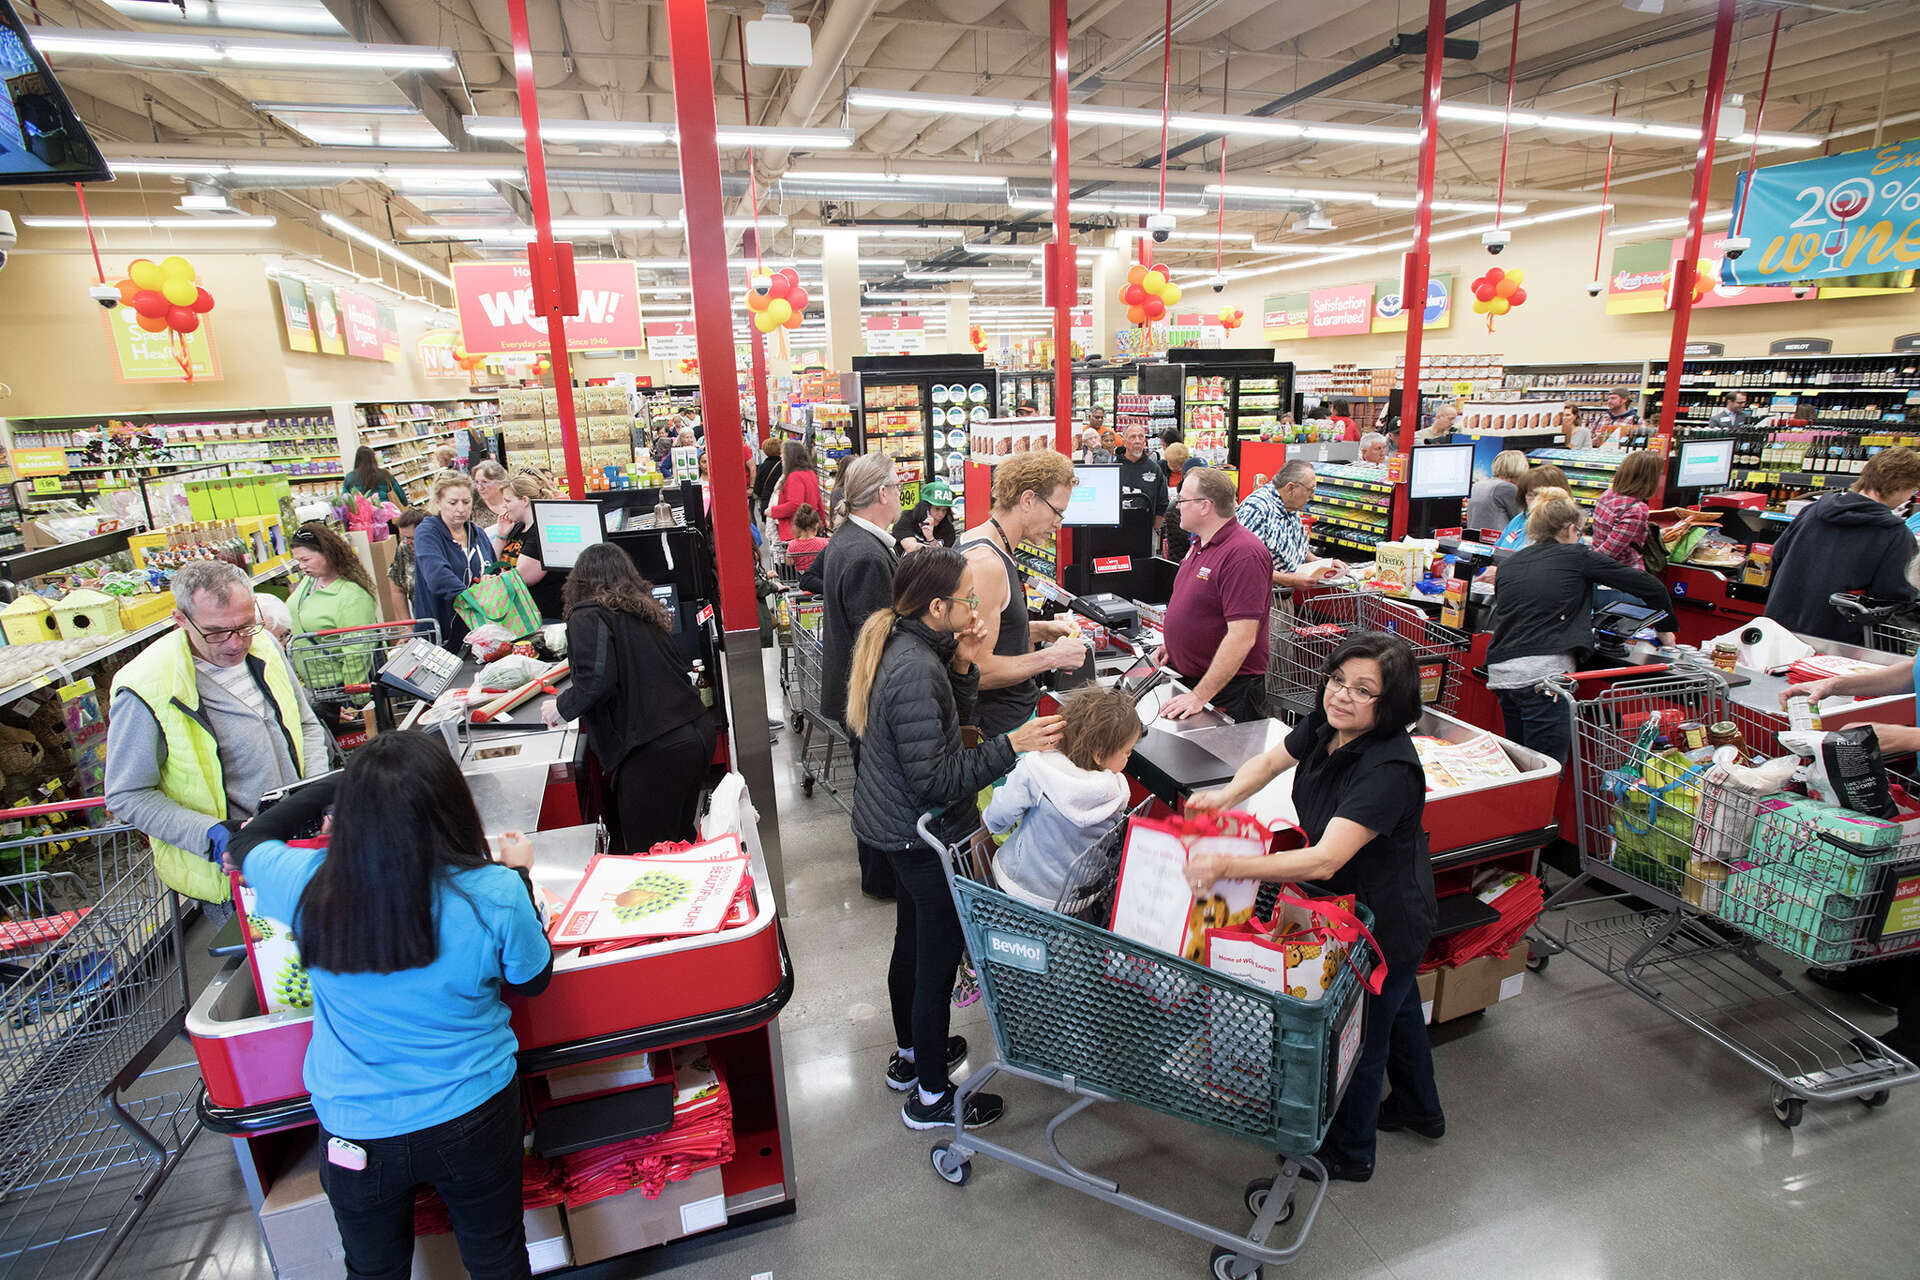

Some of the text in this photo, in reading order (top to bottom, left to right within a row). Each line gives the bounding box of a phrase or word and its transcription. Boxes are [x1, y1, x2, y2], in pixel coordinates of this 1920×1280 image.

[1313, 297, 1366, 313] Satisfaction
[891, 318, 899, 329] 3
[1075, 315, 1081, 325] 4
[1197, 314, 1204, 325] 5
[1313, 312, 1364, 326] Guaranteed
[675, 323, 684, 335] 2
[501, 341, 537, 349] Everyday
[568, 338, 588, 346] Since
[590, 337, 608, 345] 1946
[992, 938, 1041, 960] BevMo!
